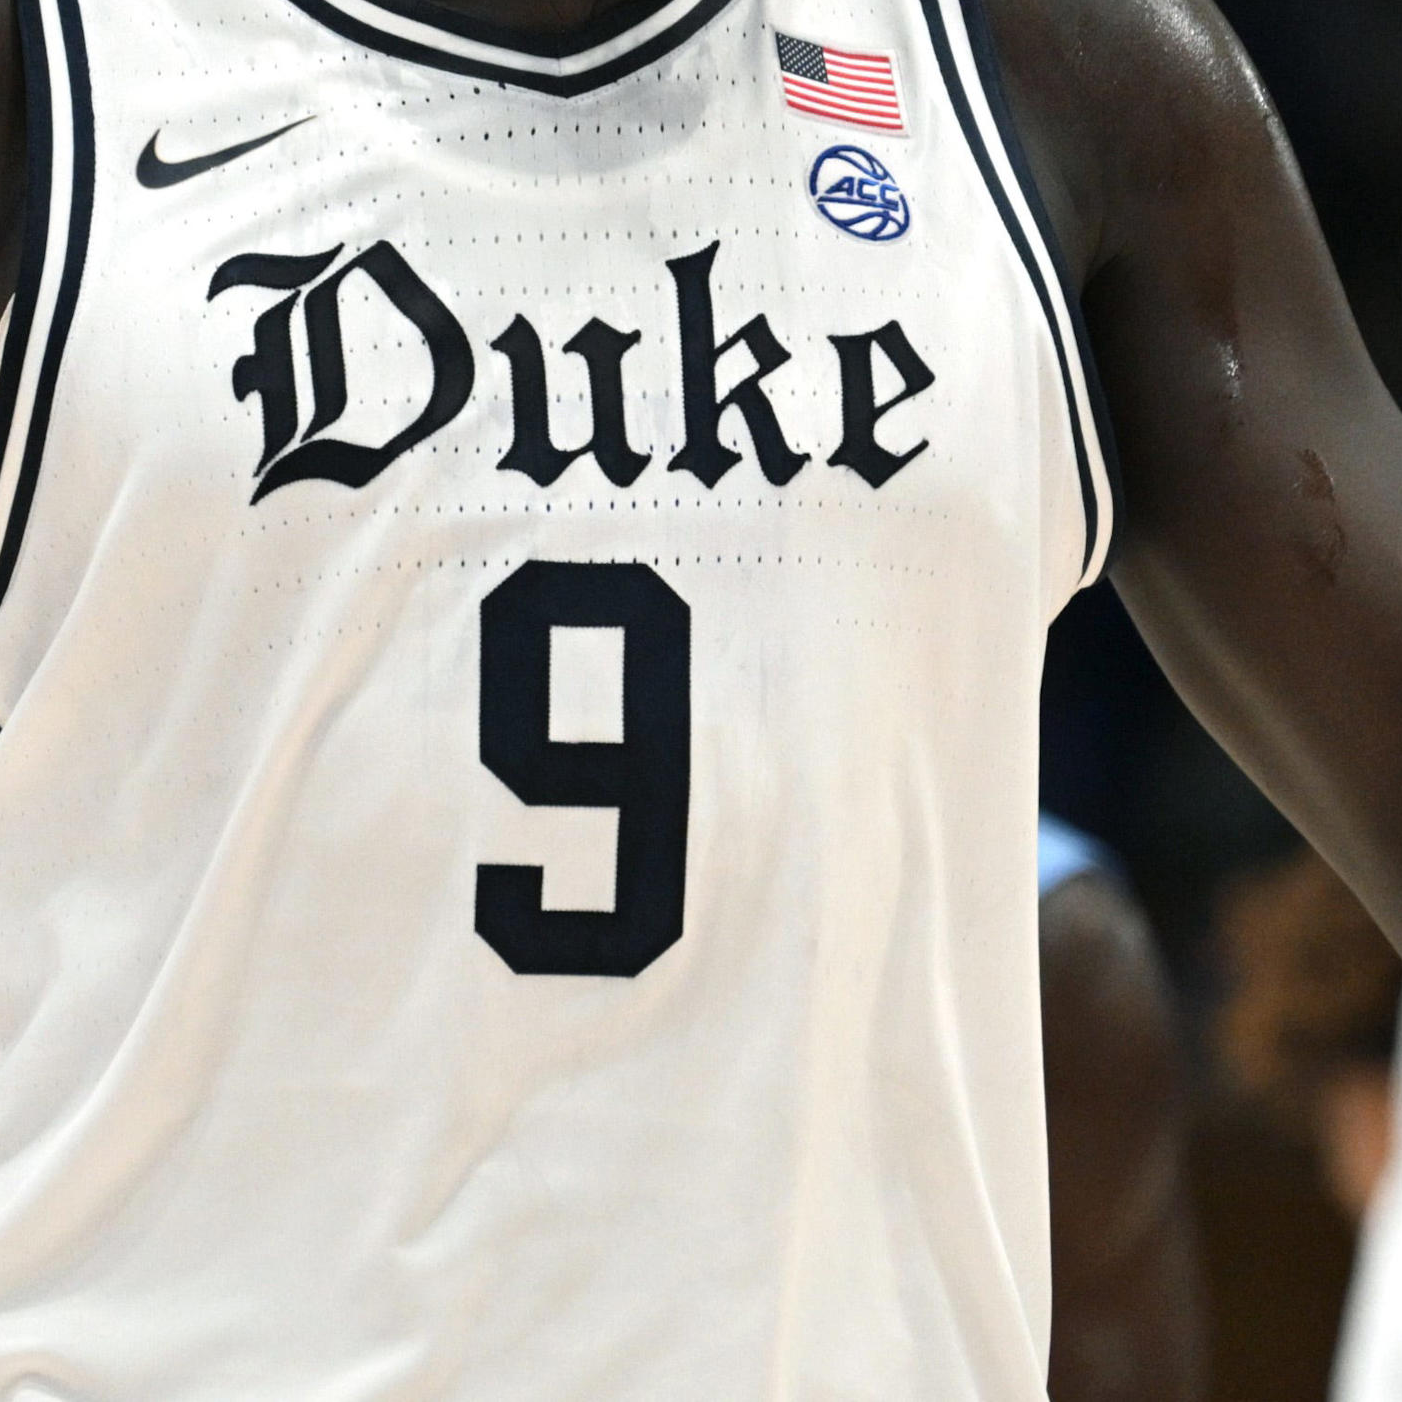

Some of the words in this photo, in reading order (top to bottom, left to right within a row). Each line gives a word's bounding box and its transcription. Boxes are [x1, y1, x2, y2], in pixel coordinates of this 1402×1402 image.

[825, 175, 900, 211] ACC
[206, 238, 937, 507] Duke
[474, 557, 692, 980] 9
